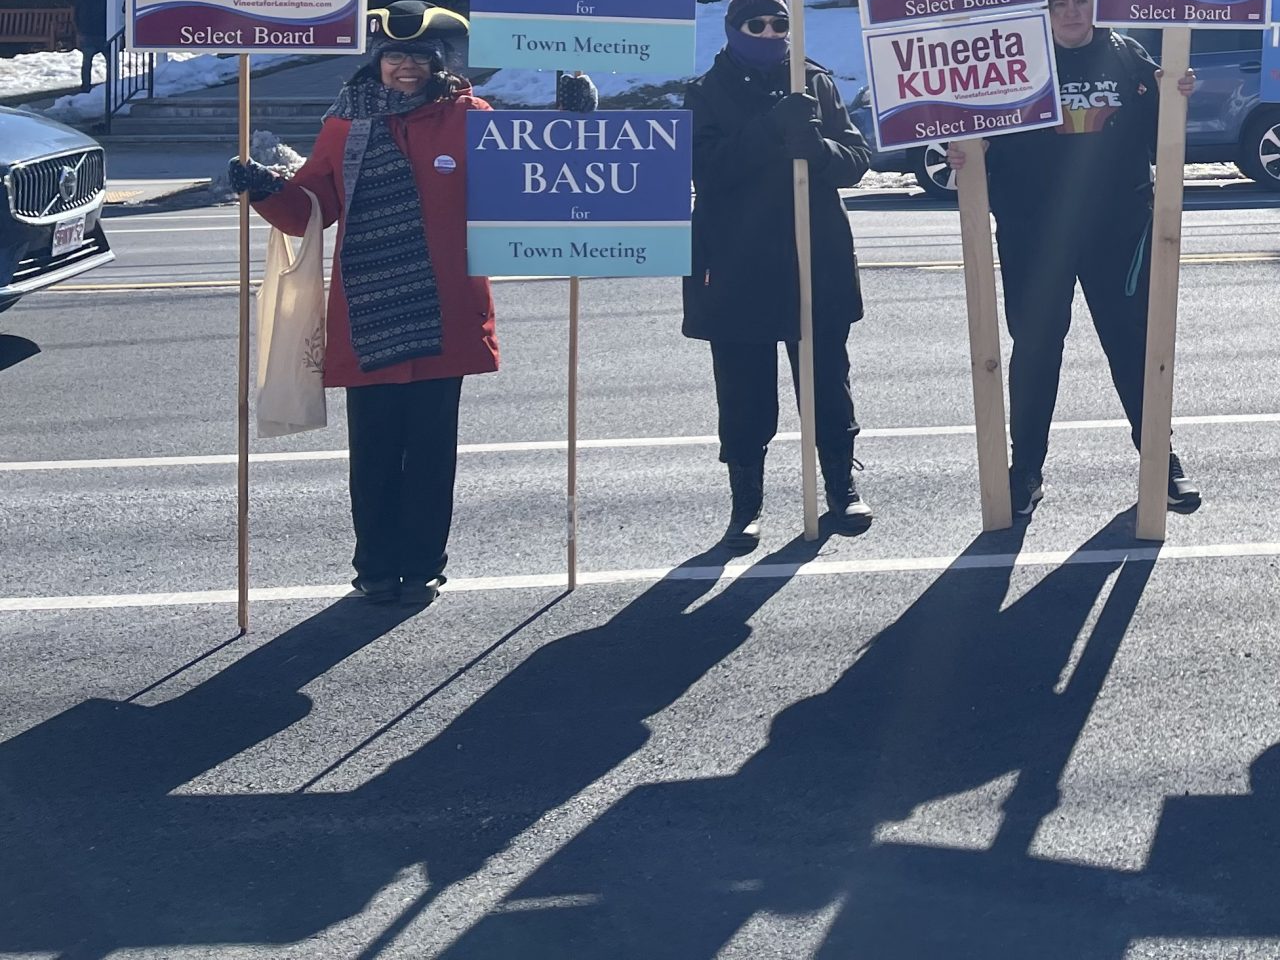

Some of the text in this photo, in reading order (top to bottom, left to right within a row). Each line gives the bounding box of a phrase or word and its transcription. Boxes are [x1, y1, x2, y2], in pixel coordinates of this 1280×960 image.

[233, 0, 332, 9] VineetaforLexington.com
[575, 0, 596, 15] for
[1129, 4, 1232, 21] Select Board
[180, 26, 315, 45] Select Board
[511, 34, 651, 61] Town Meeting
[891, 28, 1025, 72] Vineeta
[897, 59, 1030, 100] KUMAR
[1095, 80, 1118, 92] MY
[1060, 91, 1123, 110] PACE
[914, 109, 1023, 139] Select Board
[474, 119, 681, 151] ARCHAN
[521, 162, 641, 194] BASU
[570, 206, 591, 220] for
[508, 242, 647, 264] Town Meeting
